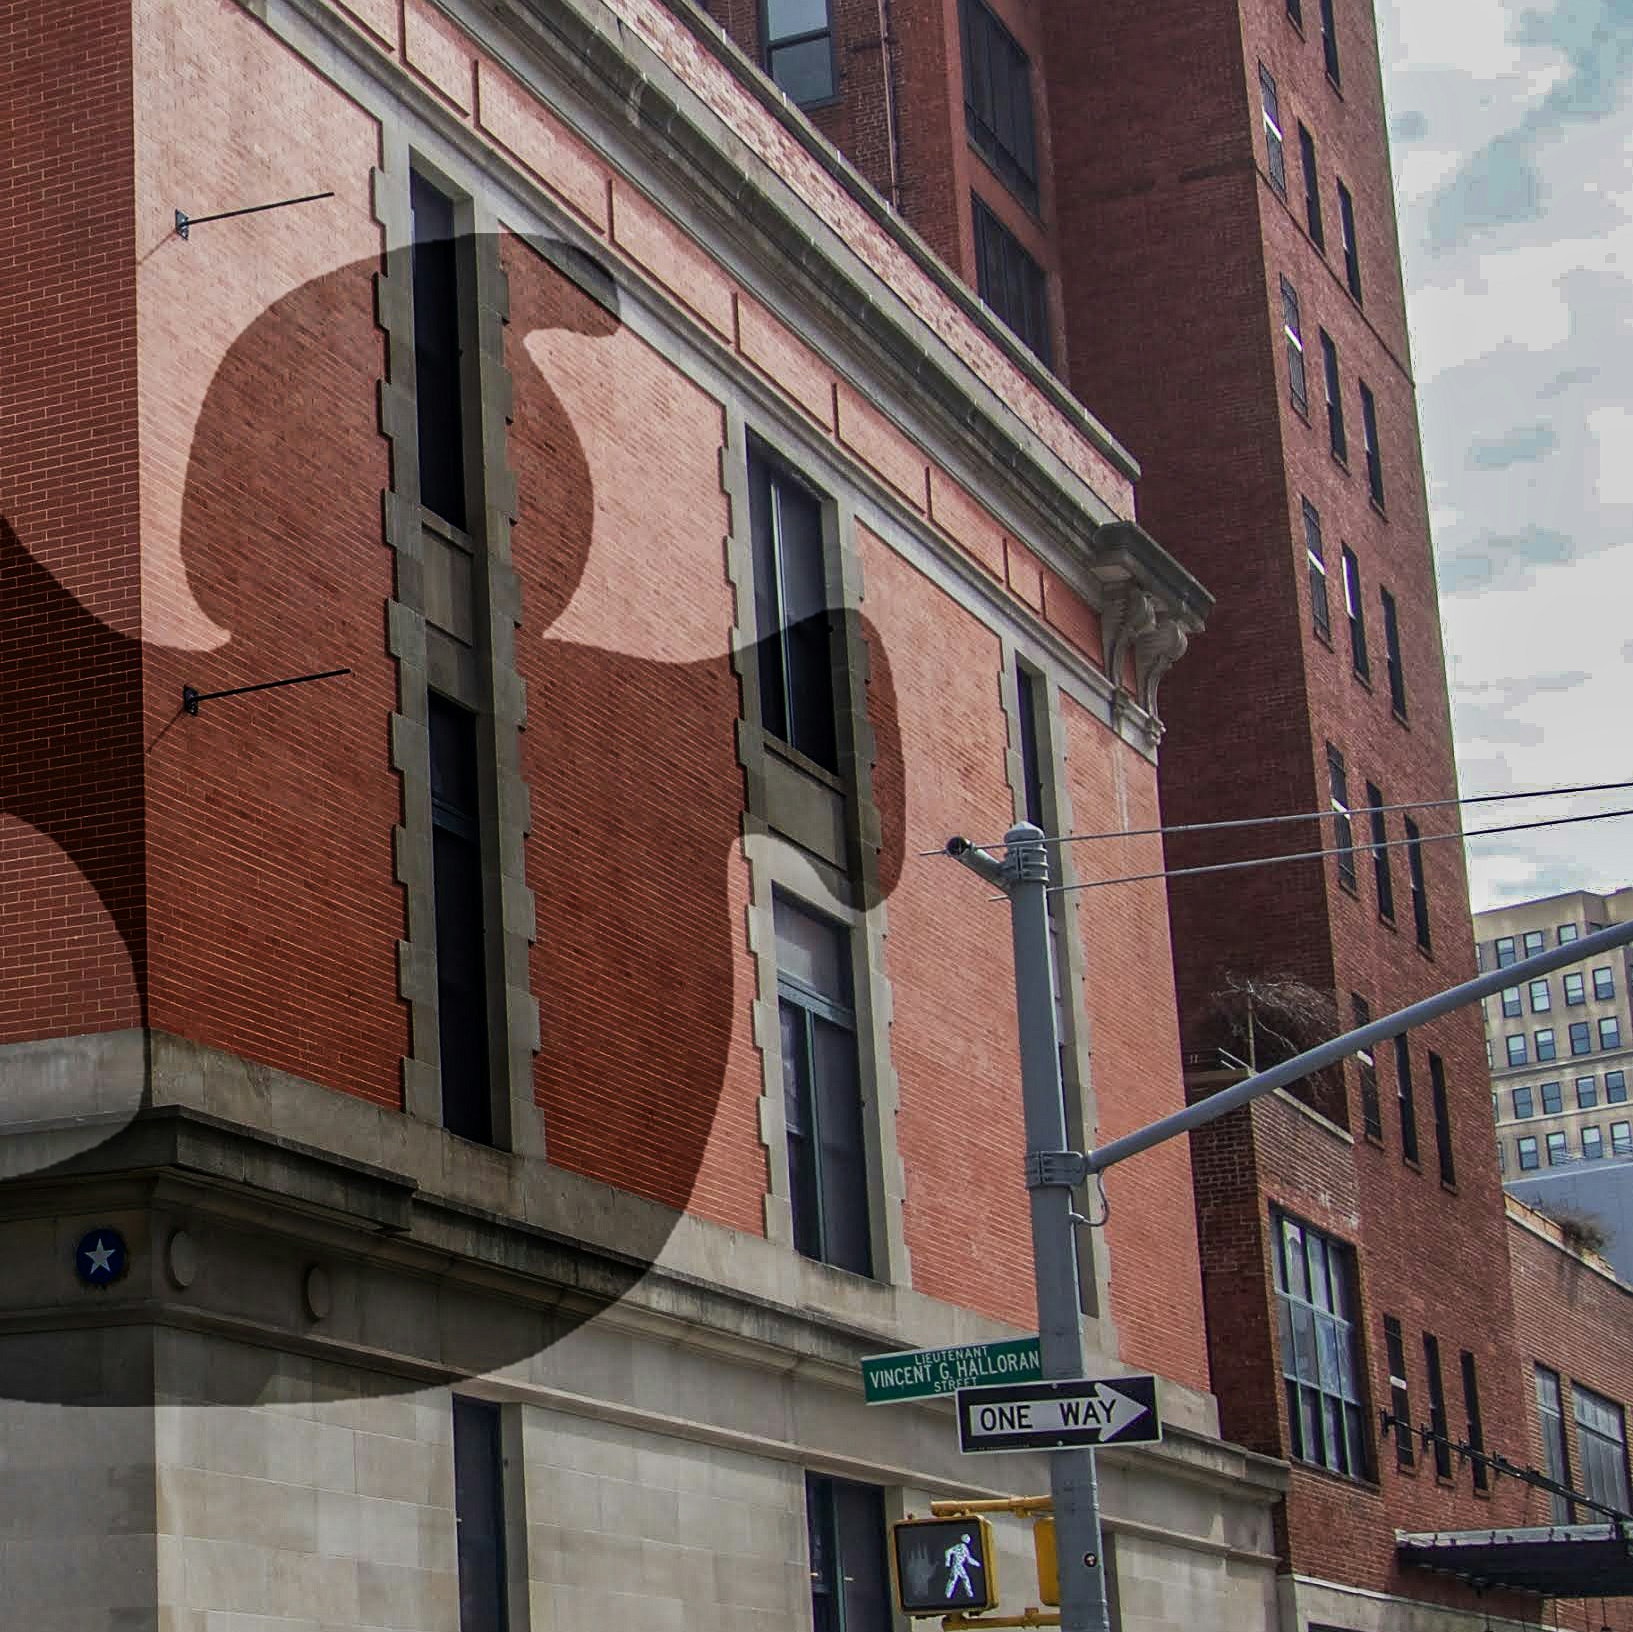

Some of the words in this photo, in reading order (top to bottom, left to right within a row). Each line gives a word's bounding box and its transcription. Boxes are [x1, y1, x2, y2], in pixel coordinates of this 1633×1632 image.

[915, 1345, 989, 1365] LIEUTENANT
[869, 1364, 933, 1389] VINCENT
[956, 1350, 1041, 1378] HALLORAN
[933, 1377, 977, 1393] STREET
[980, 1405, 1033, 1431] ONE
[1059, 1399, 1117, 1426] WAY
